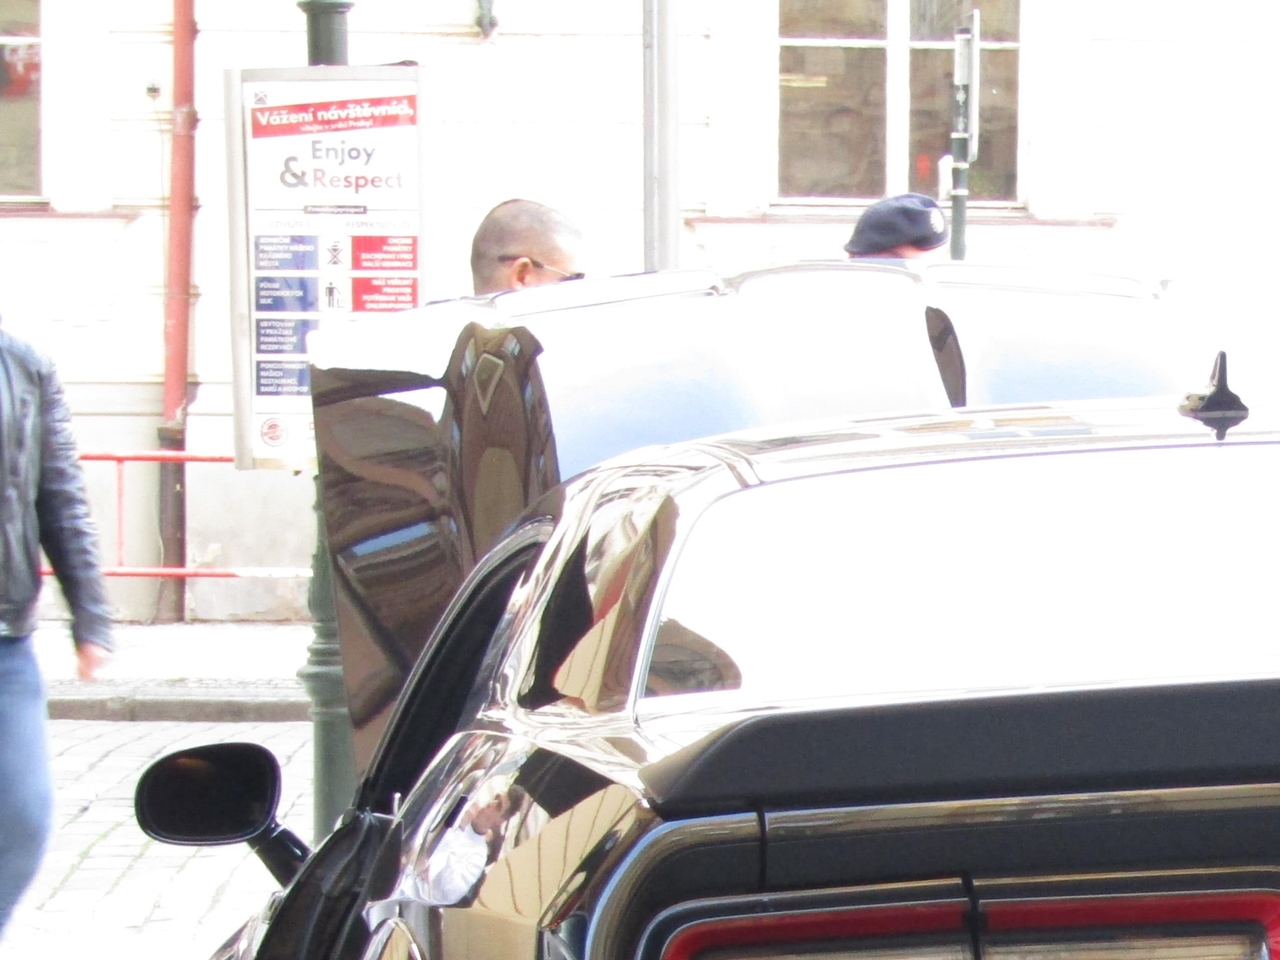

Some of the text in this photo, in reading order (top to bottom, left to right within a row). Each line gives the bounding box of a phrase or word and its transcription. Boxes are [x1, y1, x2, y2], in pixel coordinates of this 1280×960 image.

[256, 107, 314, 126] Vážení
[311, 140, 376, 166] Enjoy
[280, 156, 309, 189] &
[313, 168, 404, 194] Respect
